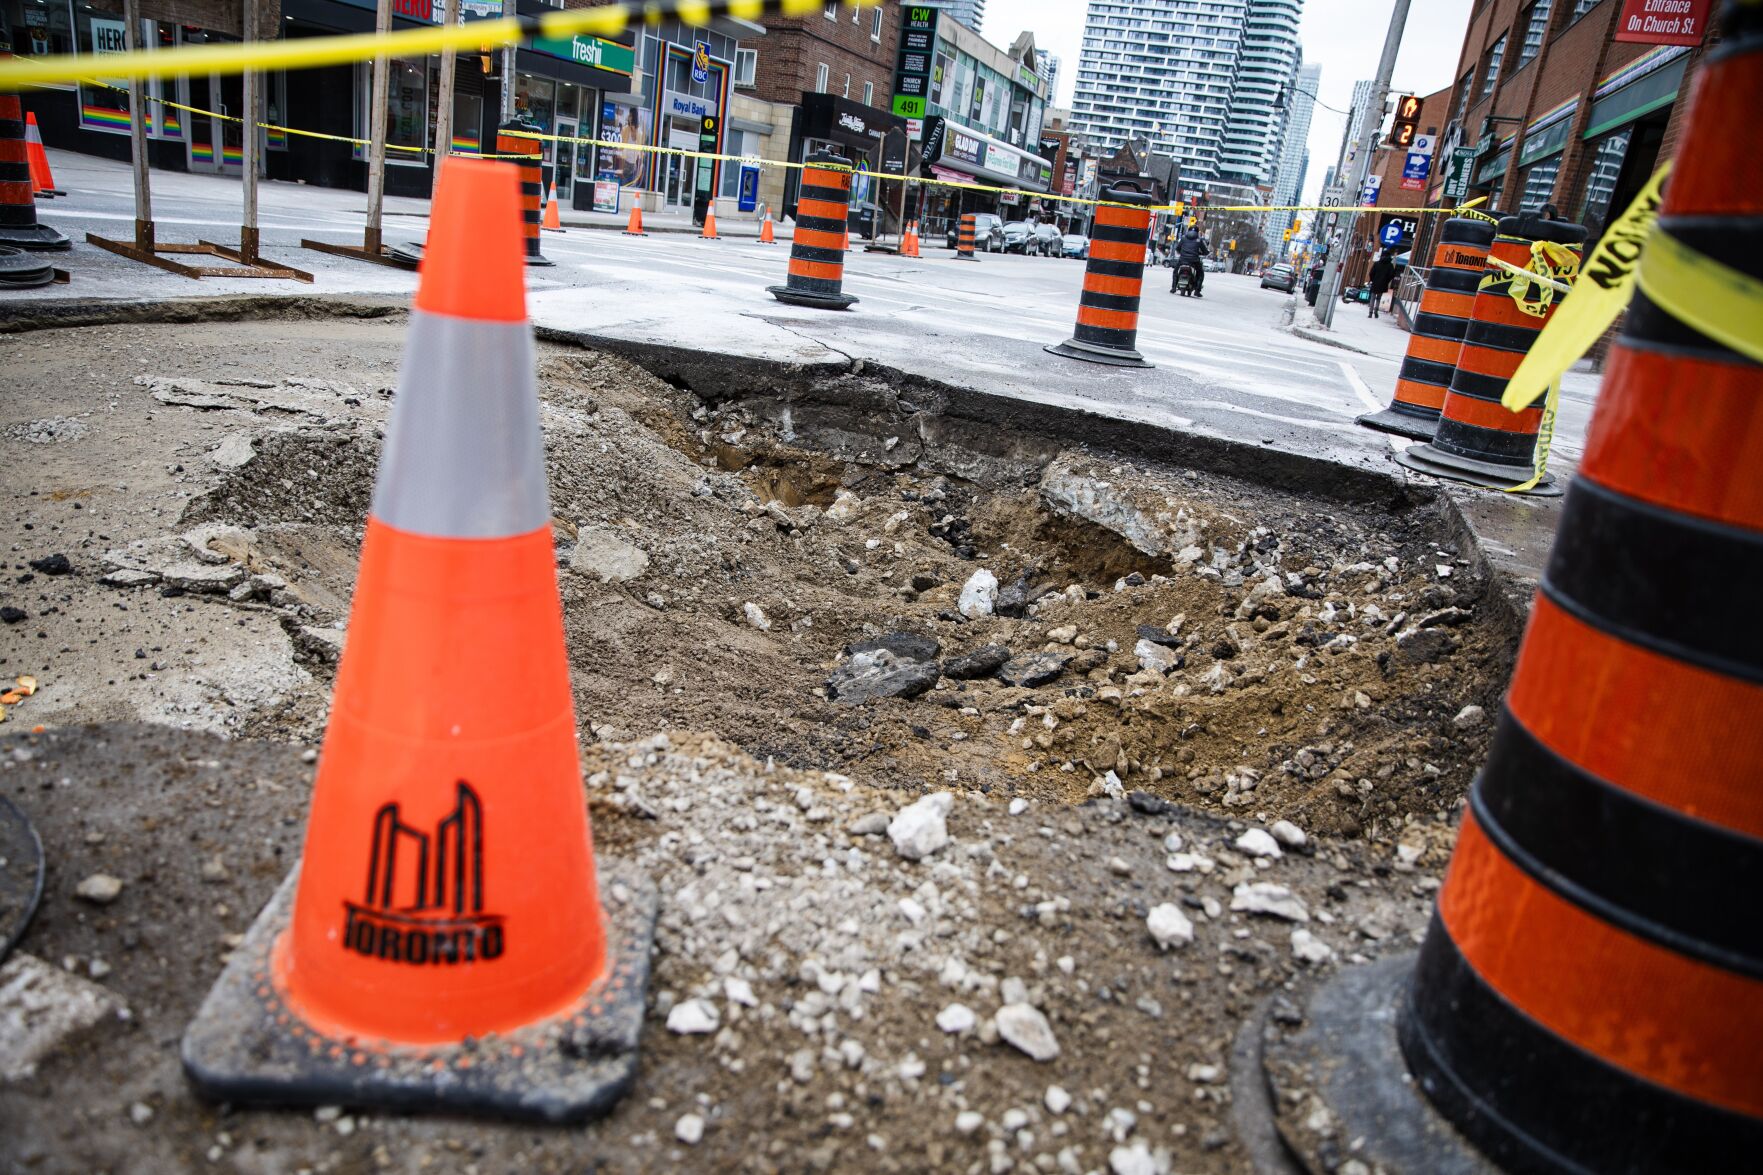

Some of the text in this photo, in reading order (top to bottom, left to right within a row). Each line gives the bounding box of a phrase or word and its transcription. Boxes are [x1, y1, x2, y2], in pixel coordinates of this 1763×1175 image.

[911, 8, 930, 21] CW
[1643, 0, 1690, 13] Entrance
[910, 20, 929, 28] HEALTH
[1627, 15, 1694, 34] On Church St.
[572, 35, 603, 65] freshii
[694, 69, 707, 81] RBC
[673, 98, 707, 116] Royal Bank
[900, 100, 919, 114] 491
[921, 117, 945, 160] BYZANTIUM
[1400, 125, 1413, 144] 2
[954, 134, 980, 154] GLAD DAY
[1456, 157, 1474, 196] CLEANERS
[1446, 177, 1459, 195] DRY
[1324, 196, 1340, 208] 30
[1386, 226, 1399, 239] P
[341, 900, 508, 965] TORONTO
